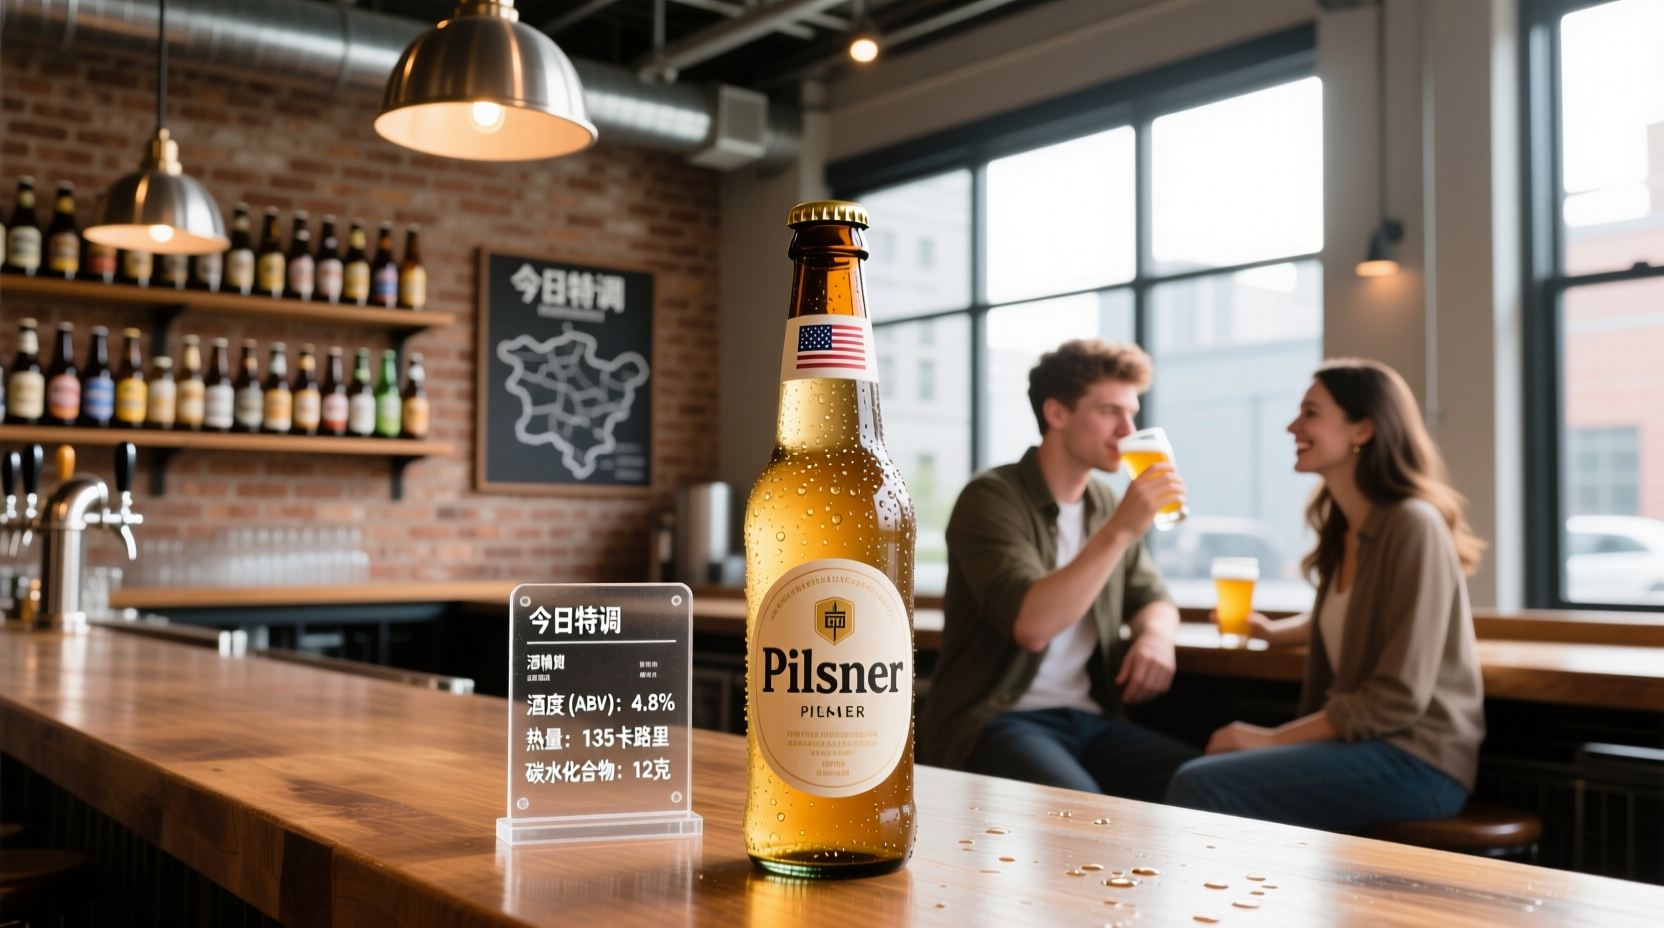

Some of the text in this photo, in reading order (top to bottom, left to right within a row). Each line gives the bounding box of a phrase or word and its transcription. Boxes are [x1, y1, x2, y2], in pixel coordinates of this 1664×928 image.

[529, 605, 622, 635] 今日特调
[762, 647, 904, 694] Pilsner
